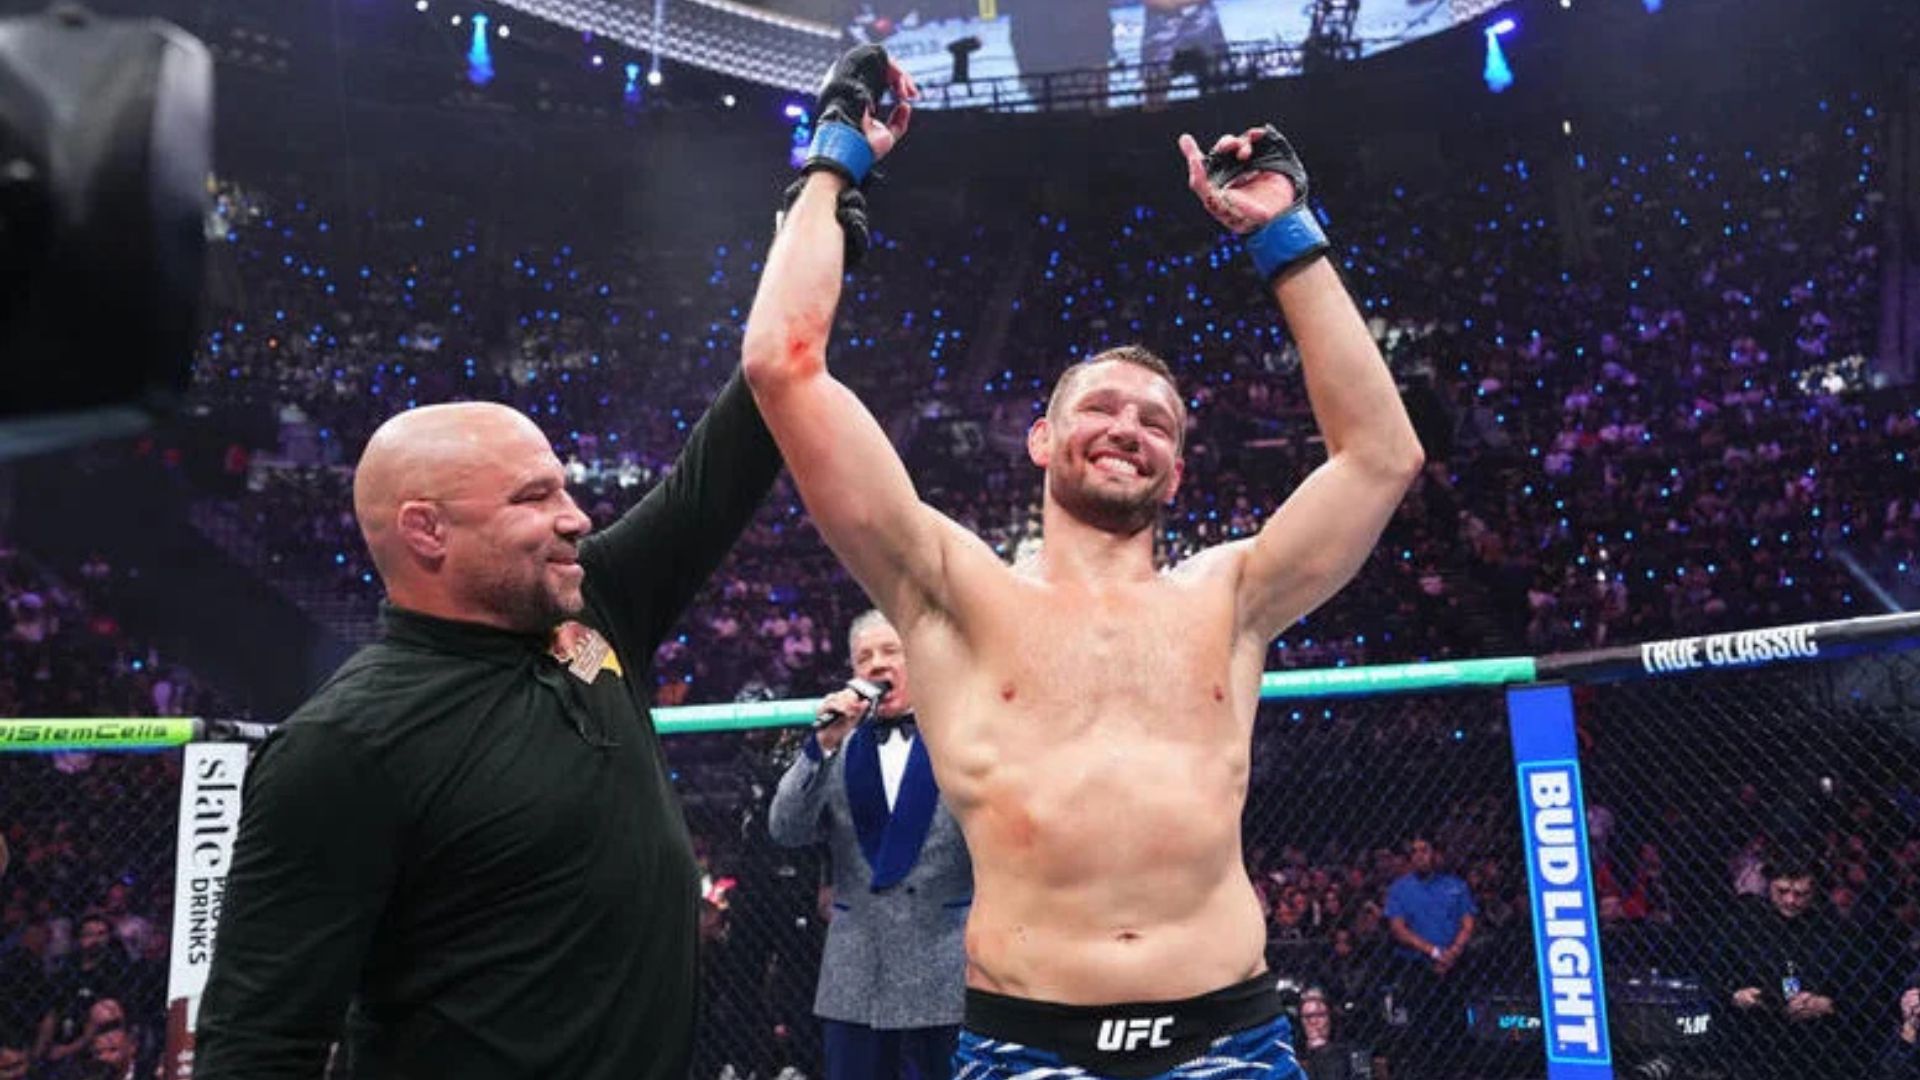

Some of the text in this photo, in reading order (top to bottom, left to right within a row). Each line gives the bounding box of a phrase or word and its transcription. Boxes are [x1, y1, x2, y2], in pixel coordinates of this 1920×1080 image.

[1641, 625, 1818, 672] TRUE CLASSIC
[192, 757, 237, 868] slate
[188, 878, 208, 965] DRINKS
[1530, 770, 1599, 1053] BUD LIGHT
[1097, 1016, 1175, 1051] UFC
